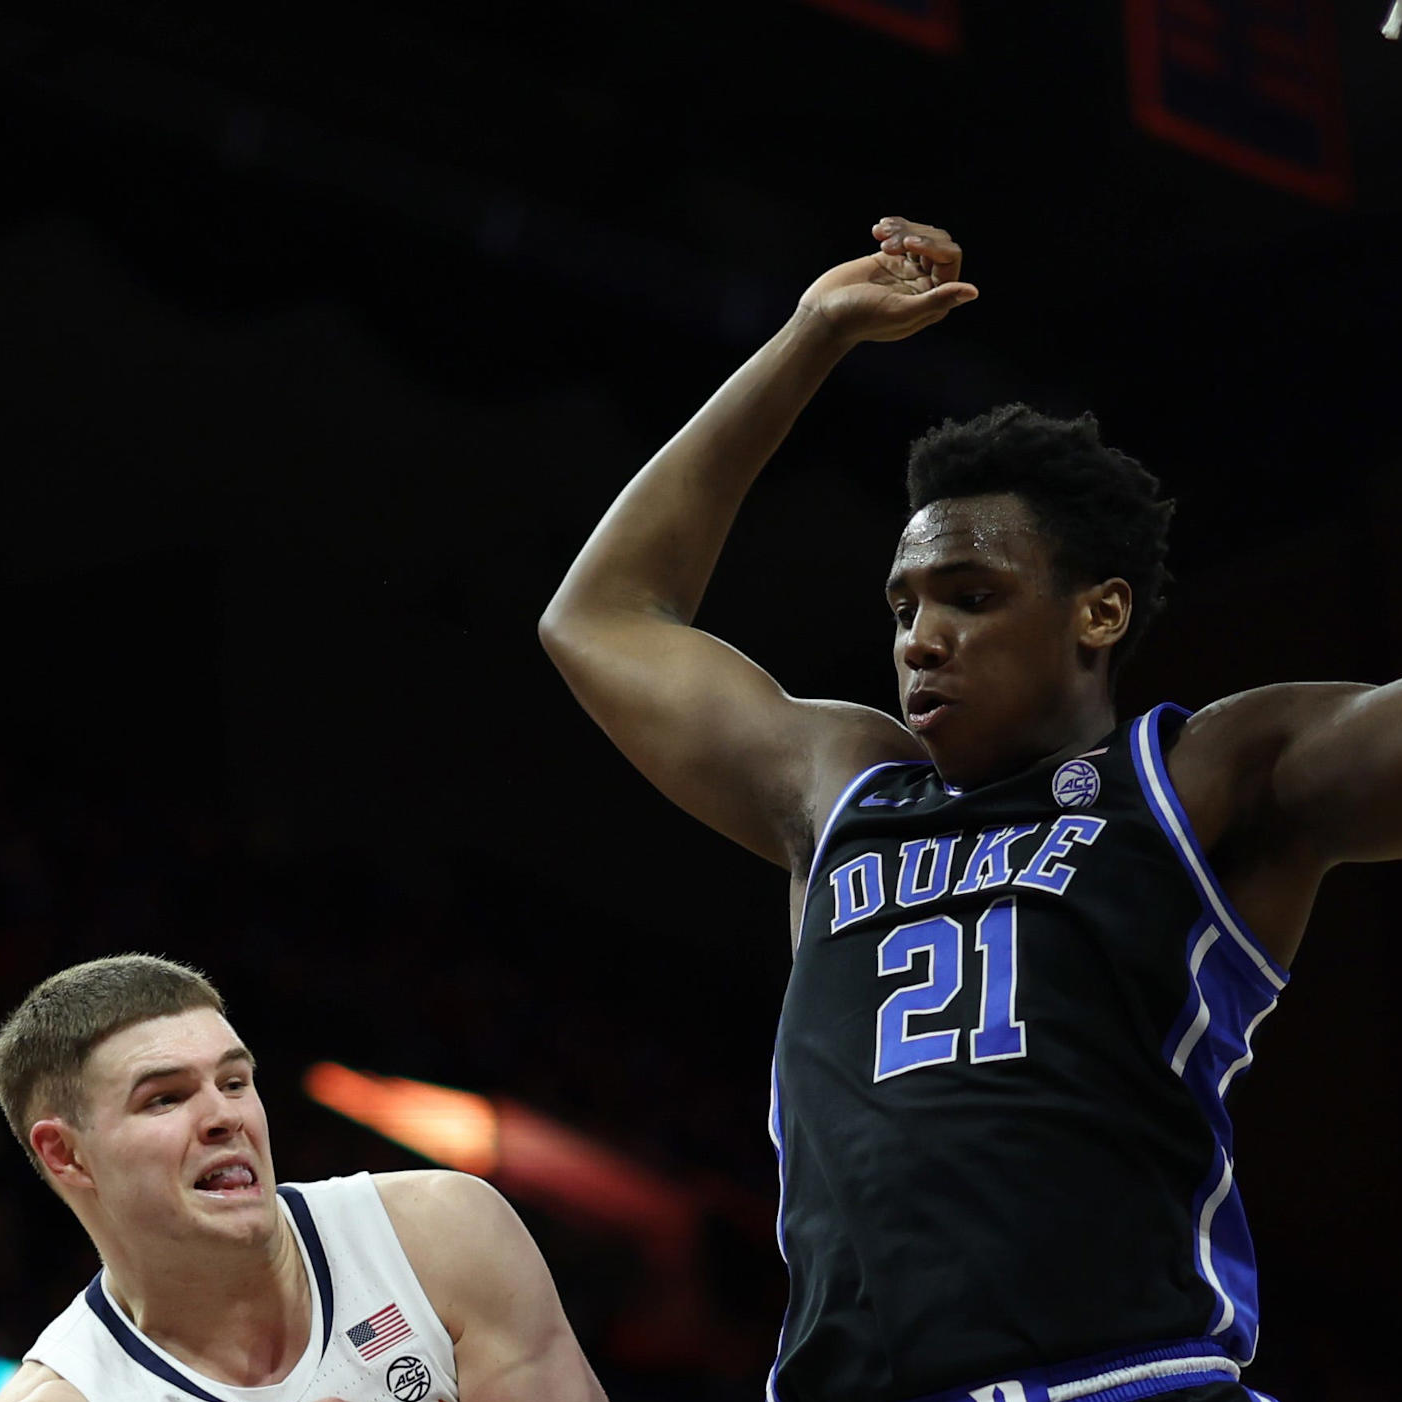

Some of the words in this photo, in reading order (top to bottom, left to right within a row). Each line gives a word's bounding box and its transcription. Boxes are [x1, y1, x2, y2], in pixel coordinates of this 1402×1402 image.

[1059, 775, 1096, 793] ACC
[829, 814, 1107, 935] DUKE
[873, 894, 1027, 1084] 21
[394, 1362, 426, 1393] ACC
